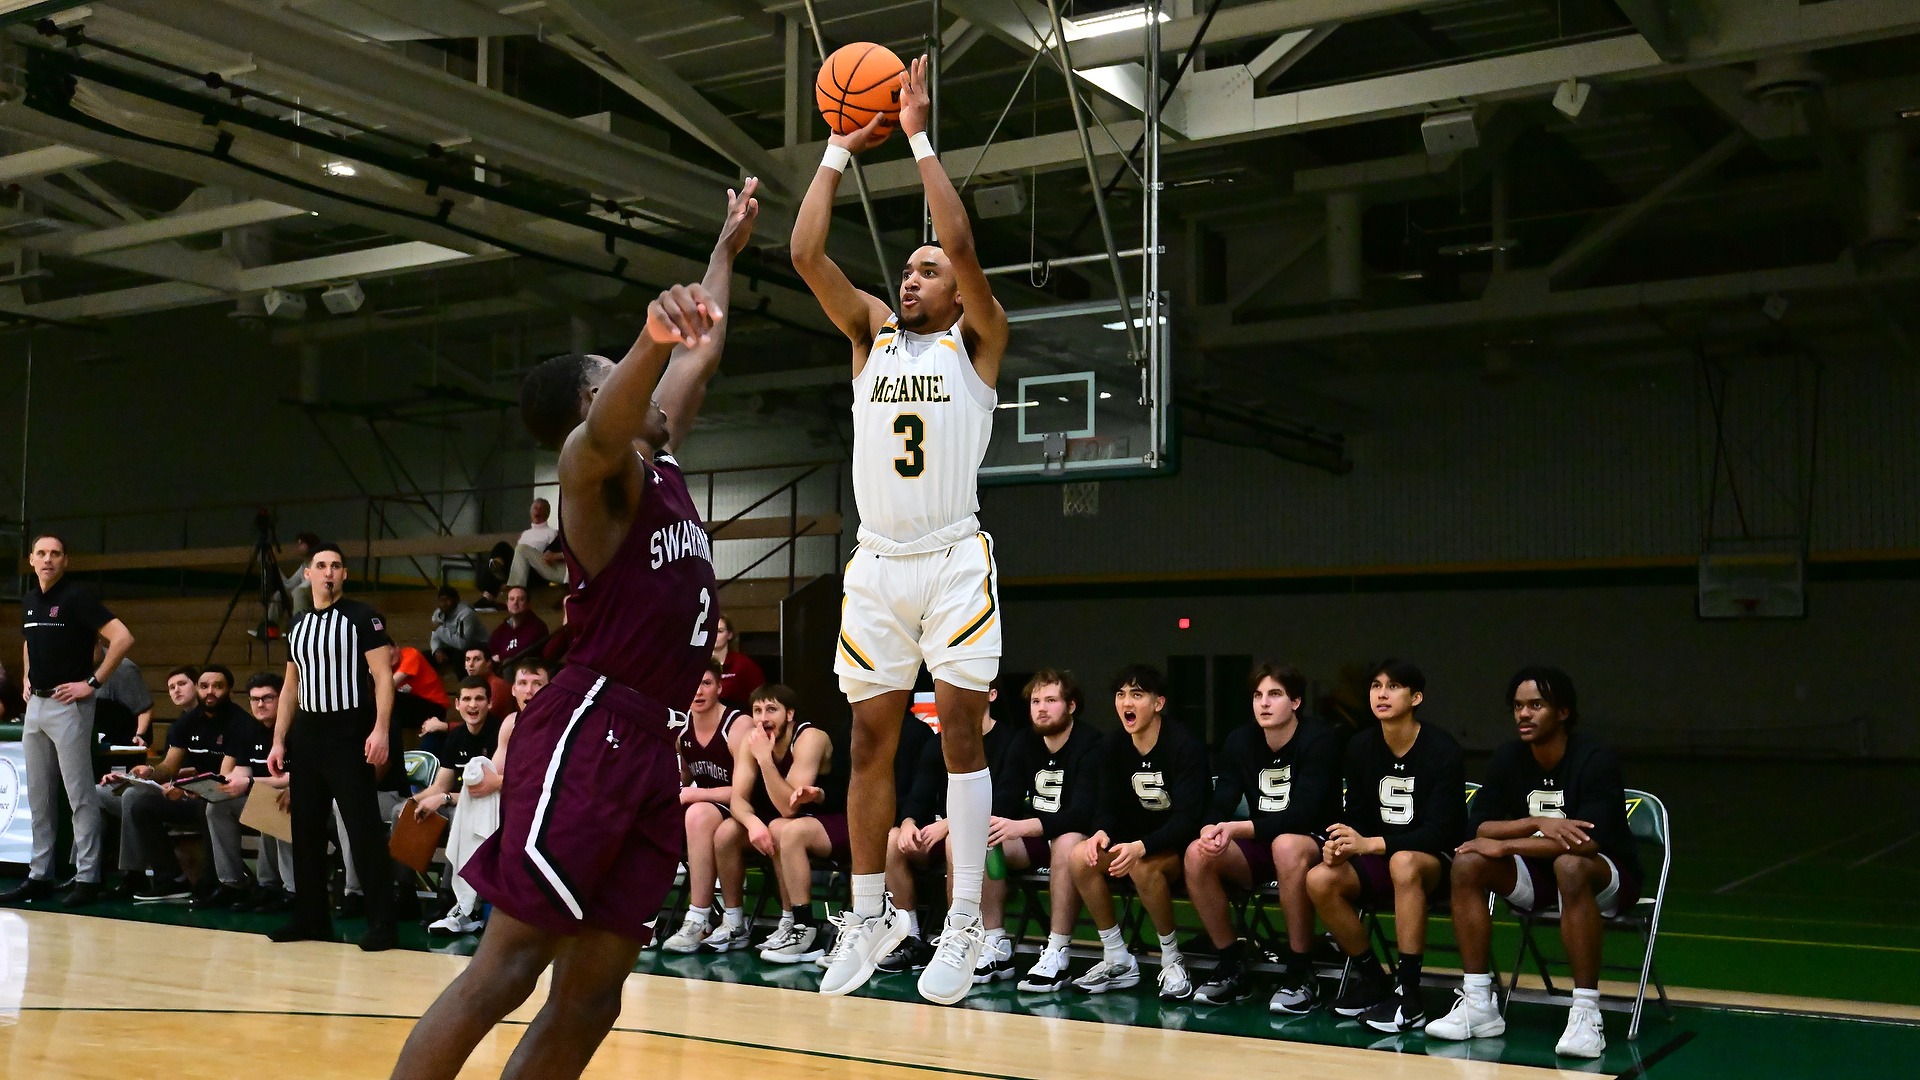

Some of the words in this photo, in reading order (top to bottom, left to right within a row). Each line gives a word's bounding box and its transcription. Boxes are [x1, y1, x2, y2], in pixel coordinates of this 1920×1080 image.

[892, 412, 926, 479] 3
[690, 587, 710, 647] 2
[1032, 769, 1065, 813] S
[1131, 771, 1172, 811] S
[1258, 764, 1292, 812] S
[1379, 775, 1416, 825] S
